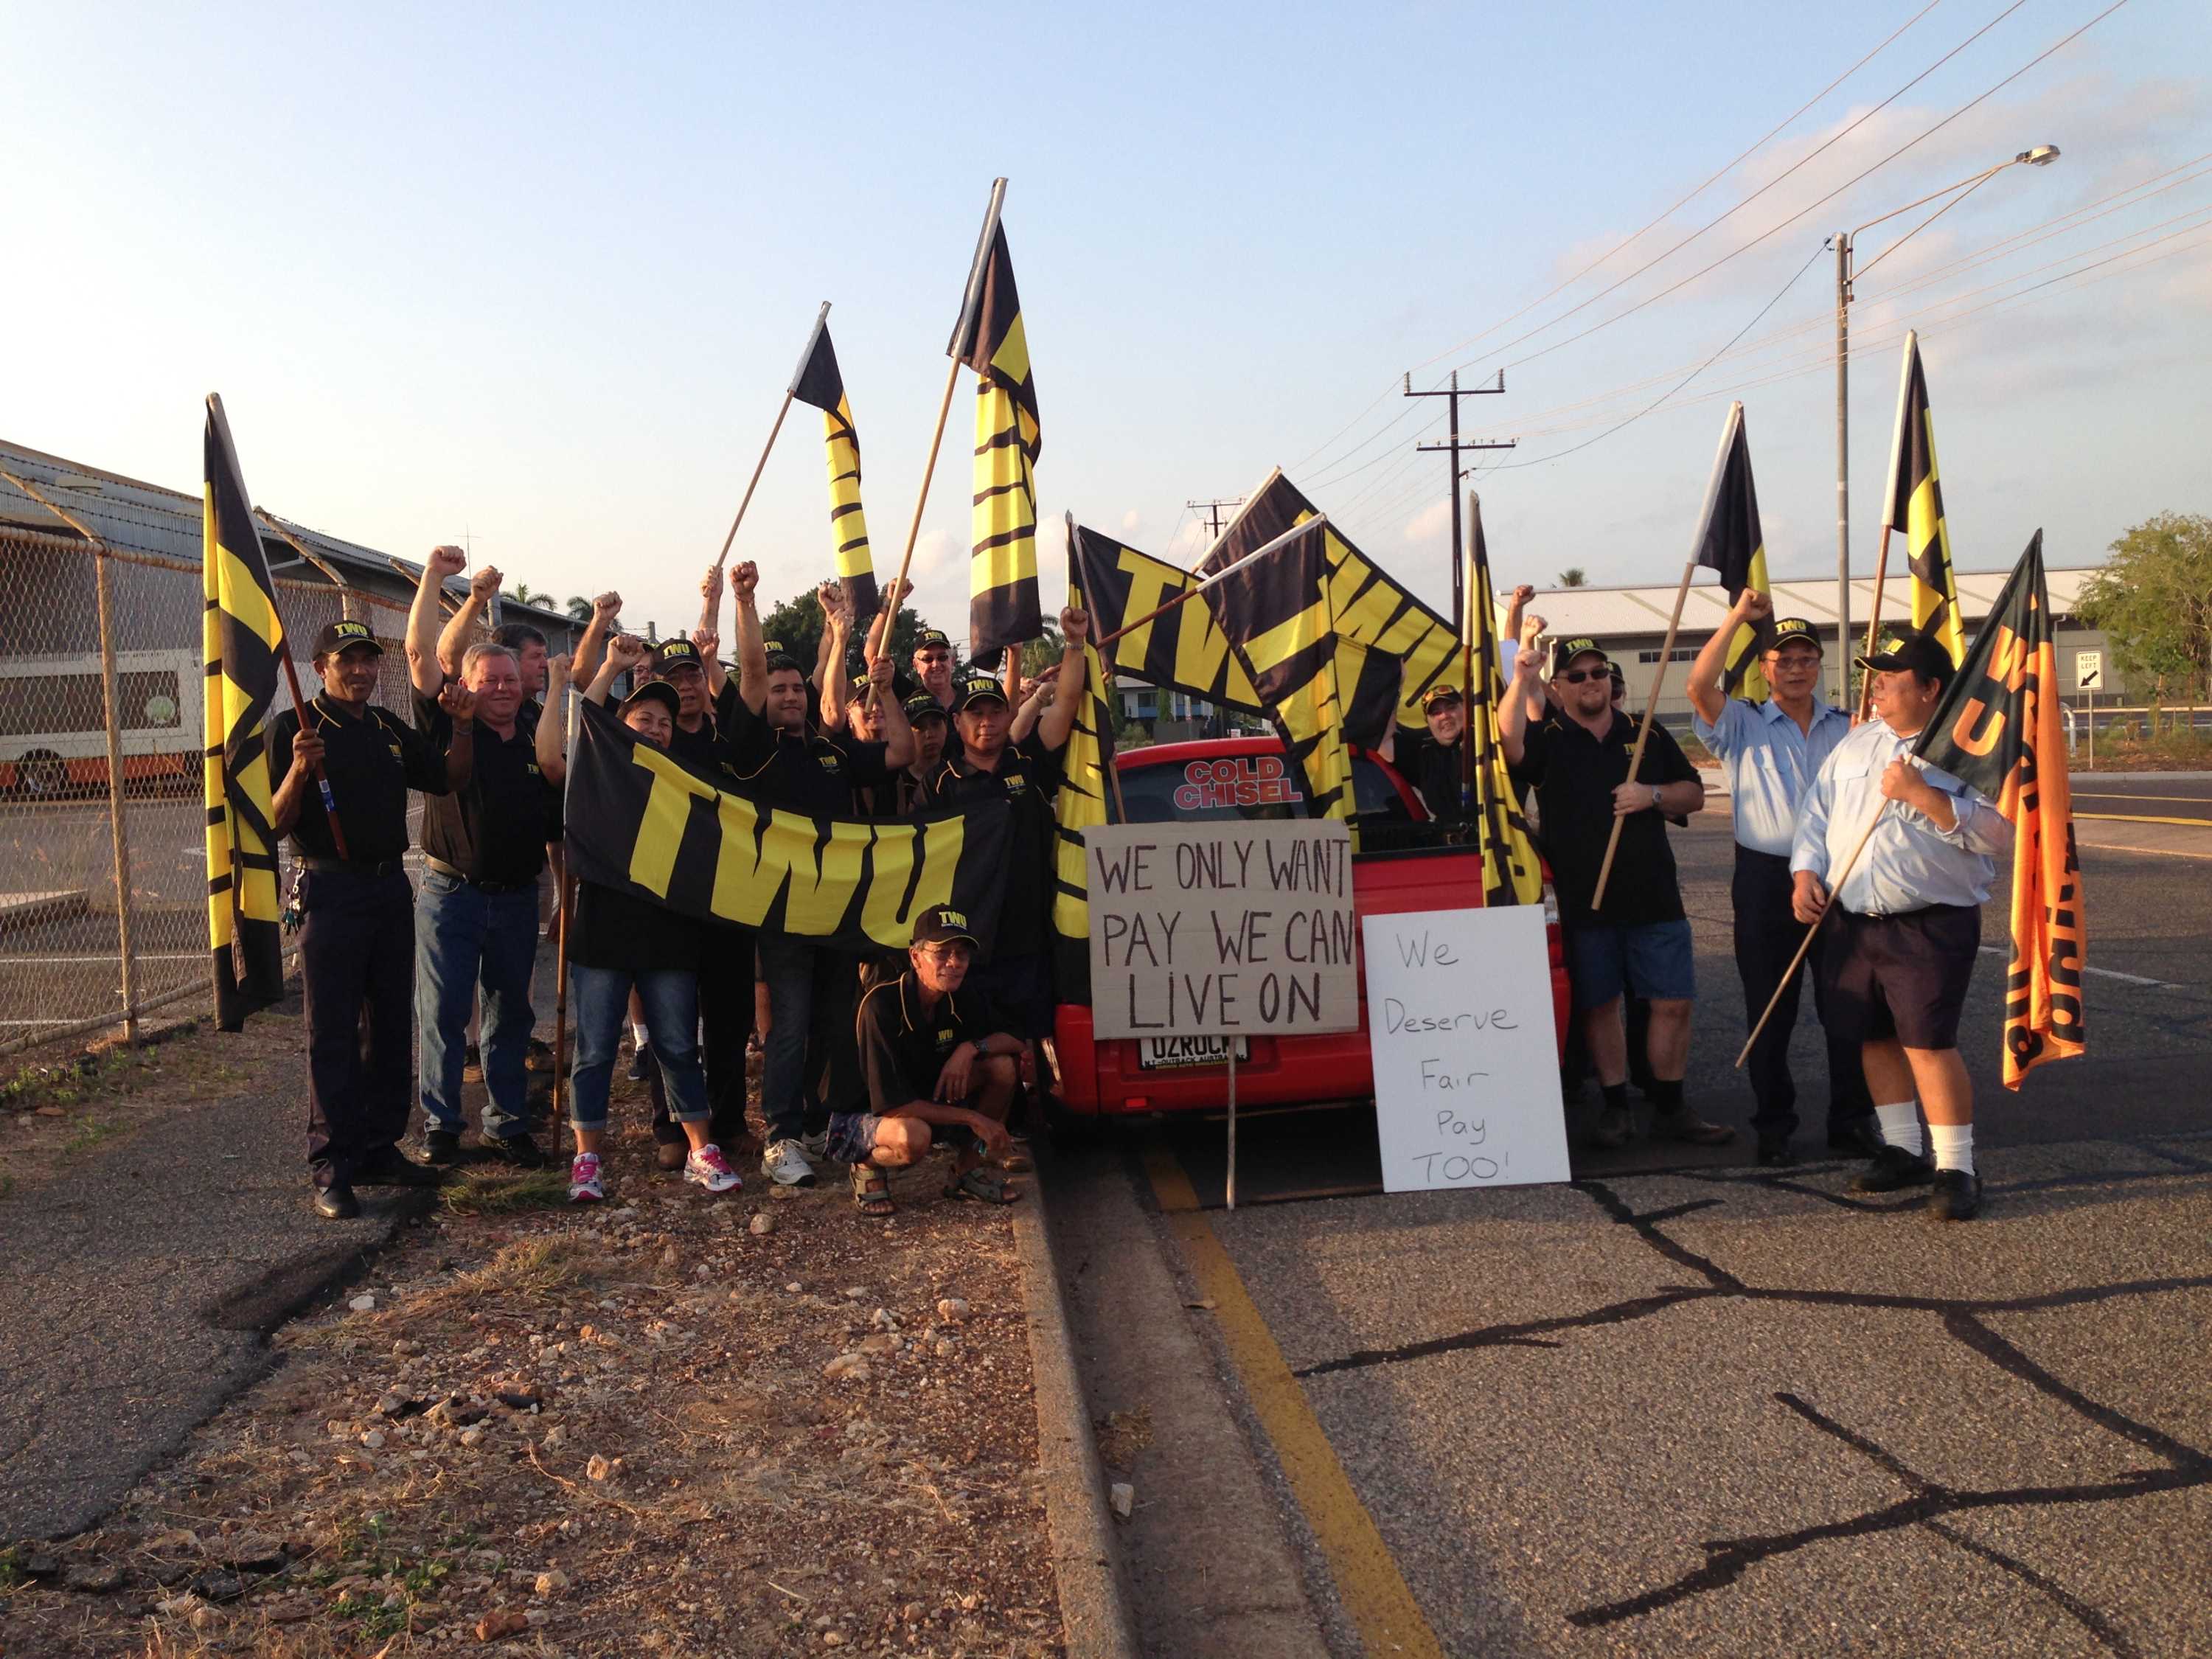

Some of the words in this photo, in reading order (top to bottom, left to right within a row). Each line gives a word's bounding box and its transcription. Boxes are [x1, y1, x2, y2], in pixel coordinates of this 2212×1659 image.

[334, 623, 368, 636] TWU
[924, 630, 942, 641] TWU
[1116, 547, 1262, 708] TW
[1775, 620, 1806, 633] TWU
[664, 643, 690, 655] TWU
[1565, 638, 1594, 650] TWU
[853, 675, 869, 686] TW
[967, 678, 995, 692] TWU
[818, 755, 838, 766] TWU
[1184, 757, 1284, 786] COLD
[1004, 773, 1025, 787] TWU
[1174, 778, 1303, 810] CHISEL
[628, 742, 965, 949] TWU
[1096, 844, 1157, 894] WE
[1176, 840, 1253, 889] ONLY
[1266, 839, 1350, 897] WANT
[938, 911, 967, 928] TWU
[1103, 911, 1181, 967] PAY
[1211, 910, 1272, 965] WE
[1285, 909, 1353, 965] CAN
[1397, 930, 1459, 968] We
[1130, 972, 1240, 1029] LIVE
[1259, 972, 1320, 1024] ON
[1384, 998, 1518, 1034] Deserve
[1421, 1059, 1489, 1090] Fair
[1438, 1110, 1486, 1145] Pay
[1412, 1152, 1509, 1183] TOO!
